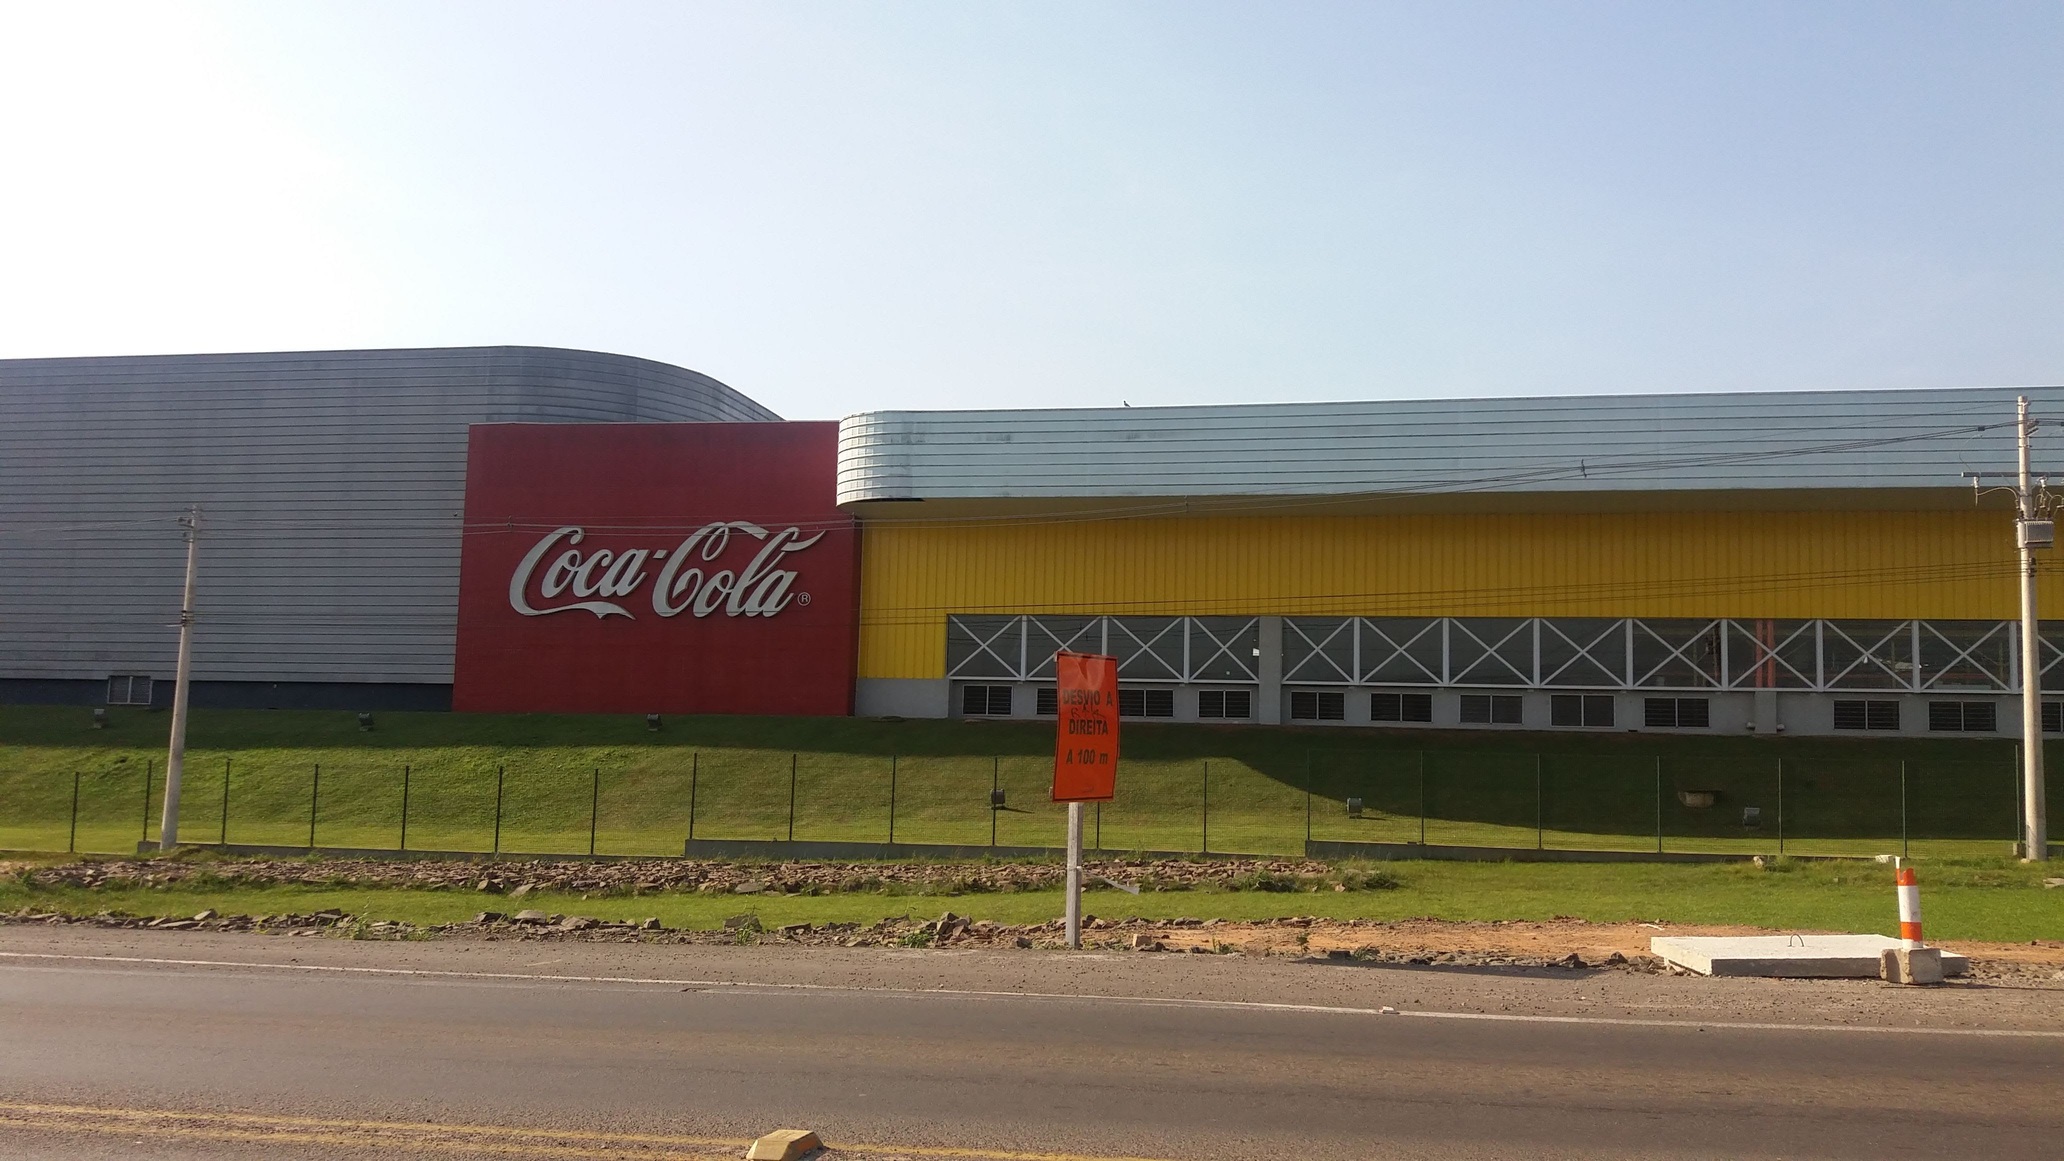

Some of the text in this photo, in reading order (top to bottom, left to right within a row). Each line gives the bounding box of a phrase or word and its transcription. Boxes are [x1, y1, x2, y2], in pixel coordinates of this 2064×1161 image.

[509, 521, 826, 620] Coca-Cola
[1063, 689, 1113, 706] DESVIO A
[1069, 719, 1108, 735] DIREITA
[1066, 749, 1108, 764] A 100 m
